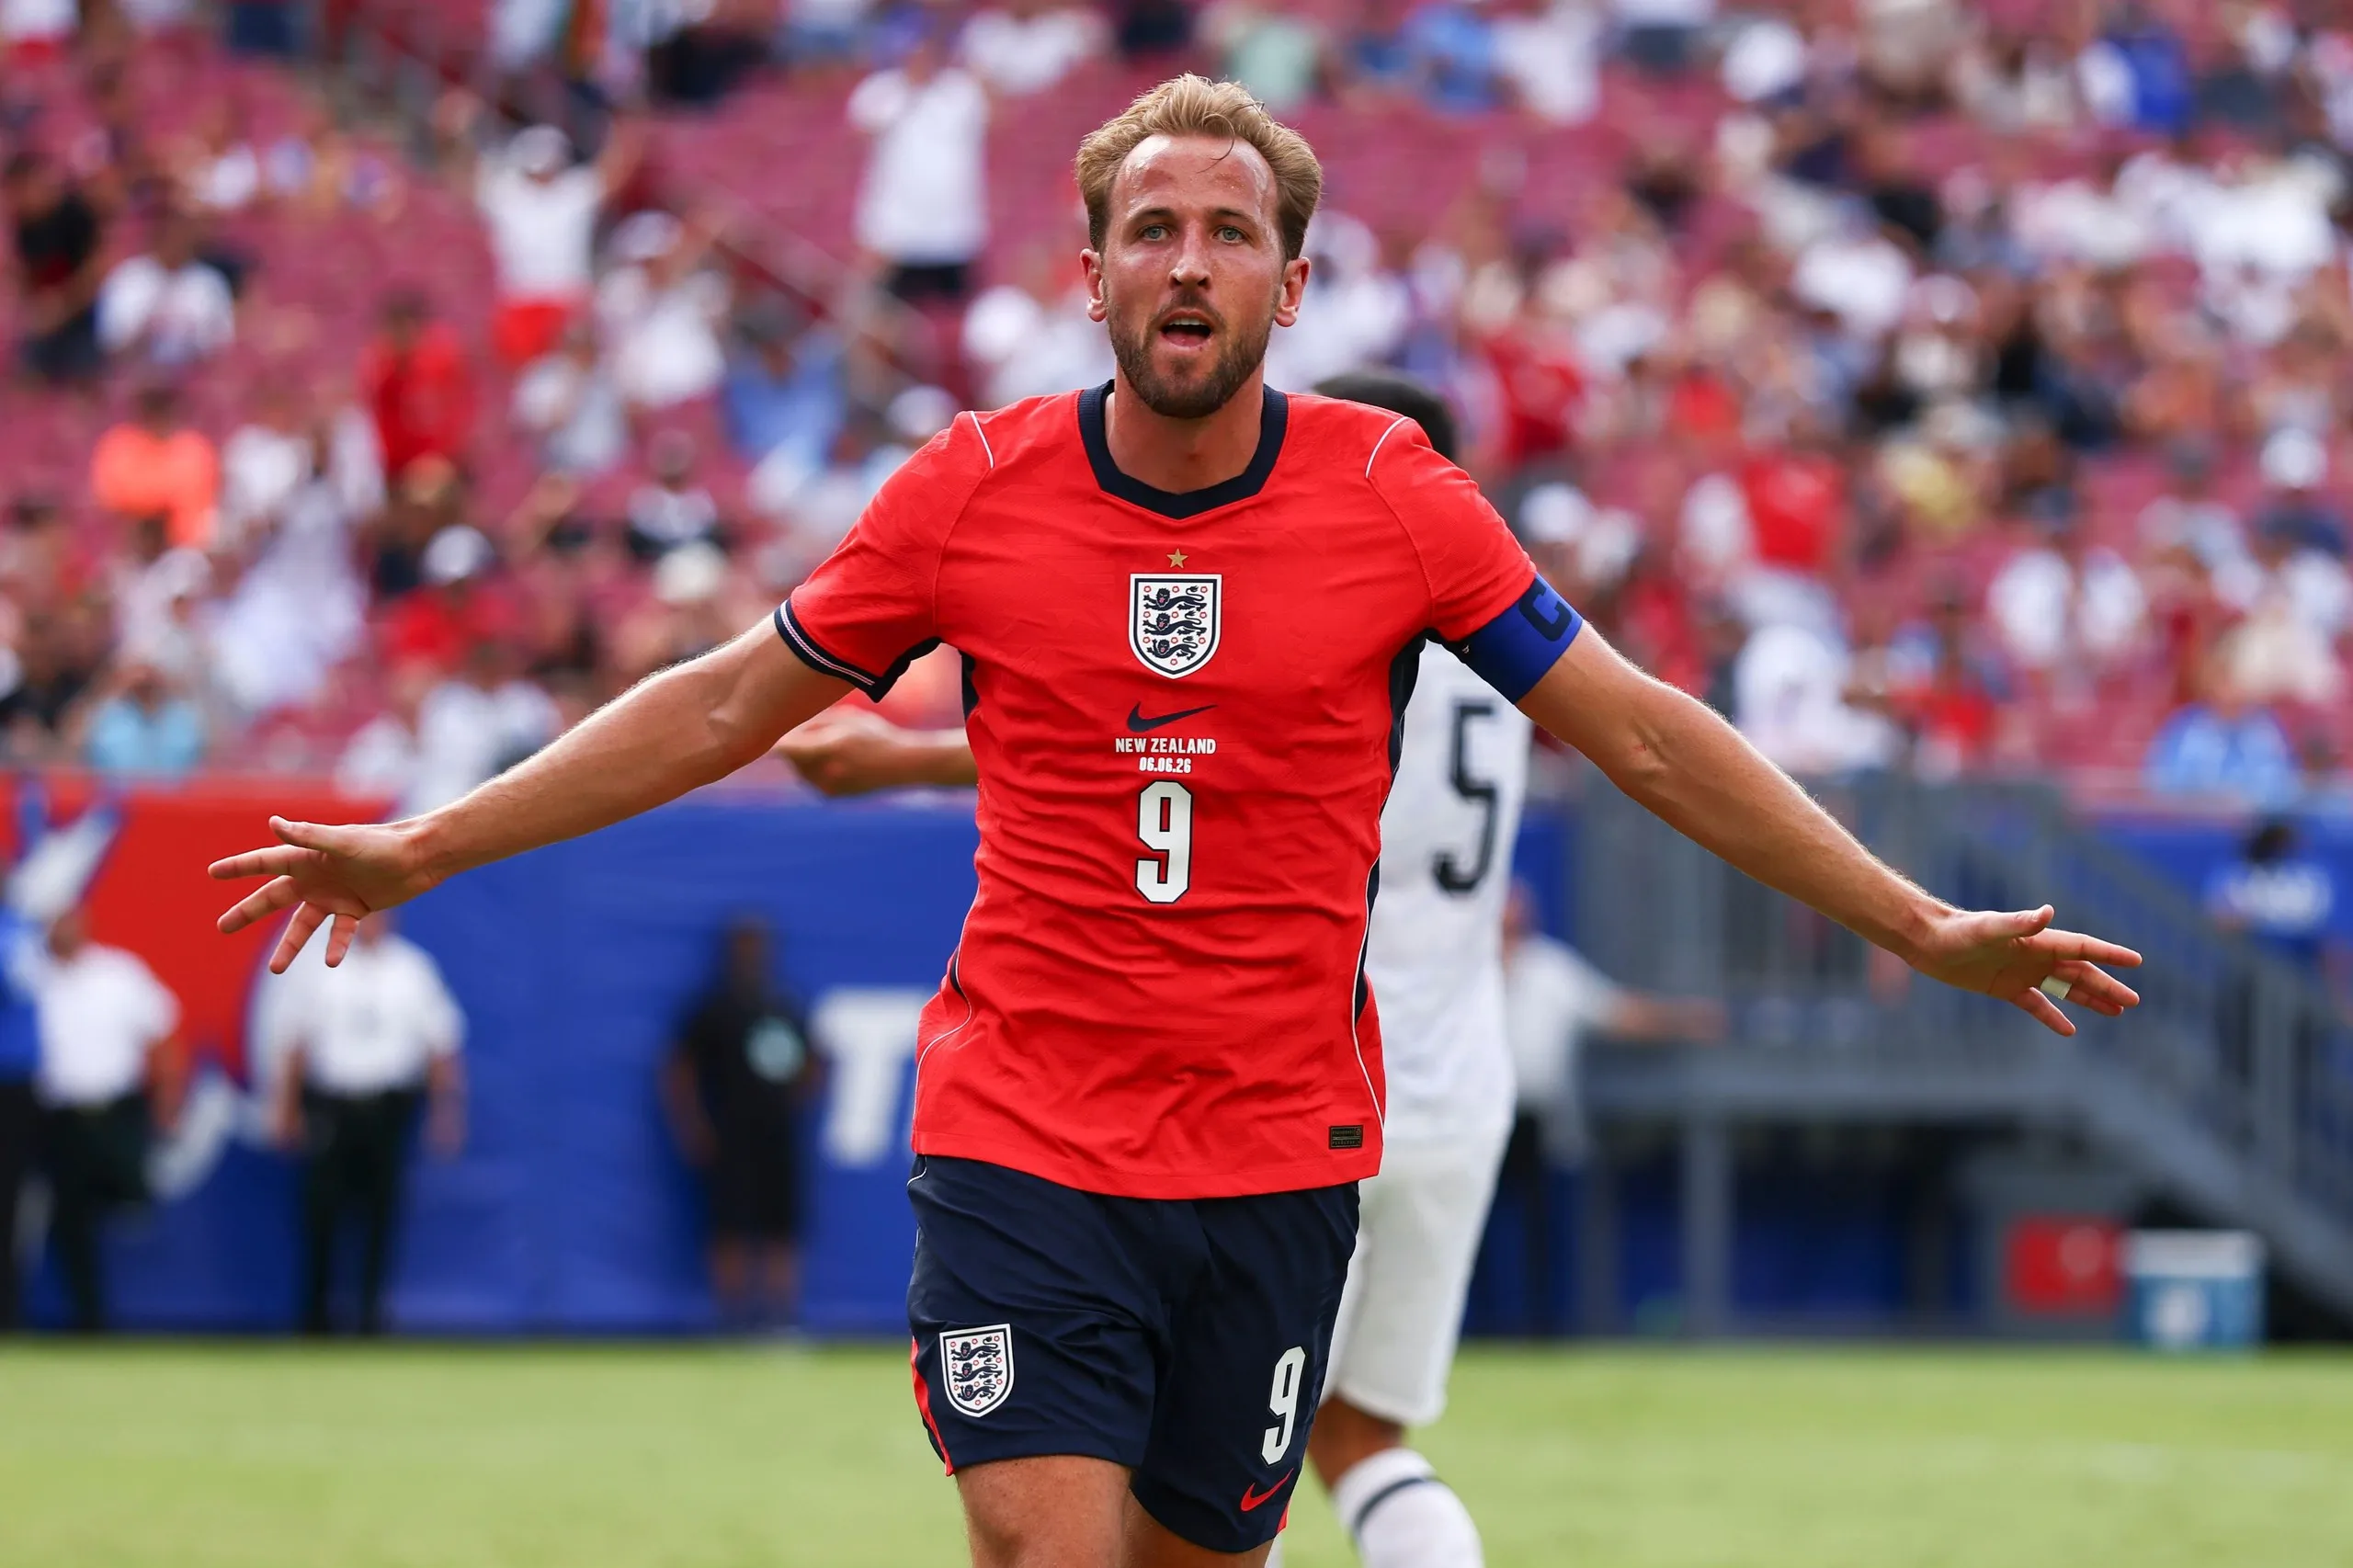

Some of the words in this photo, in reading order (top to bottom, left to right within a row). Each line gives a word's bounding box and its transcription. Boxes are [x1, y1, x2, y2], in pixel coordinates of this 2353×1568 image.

[1518, 578, 1573, 642] C
[1115, 737, 1147, 753] NEW
[1150, 737, 1217, 755] ZEALAND
[1139, 756, 1192, 774] 06.06.26
[1135, 780, 1193, 903] 9
[1433, 701, 1495, 892] 5
[1261, 1346, 1306, 1466] 9
